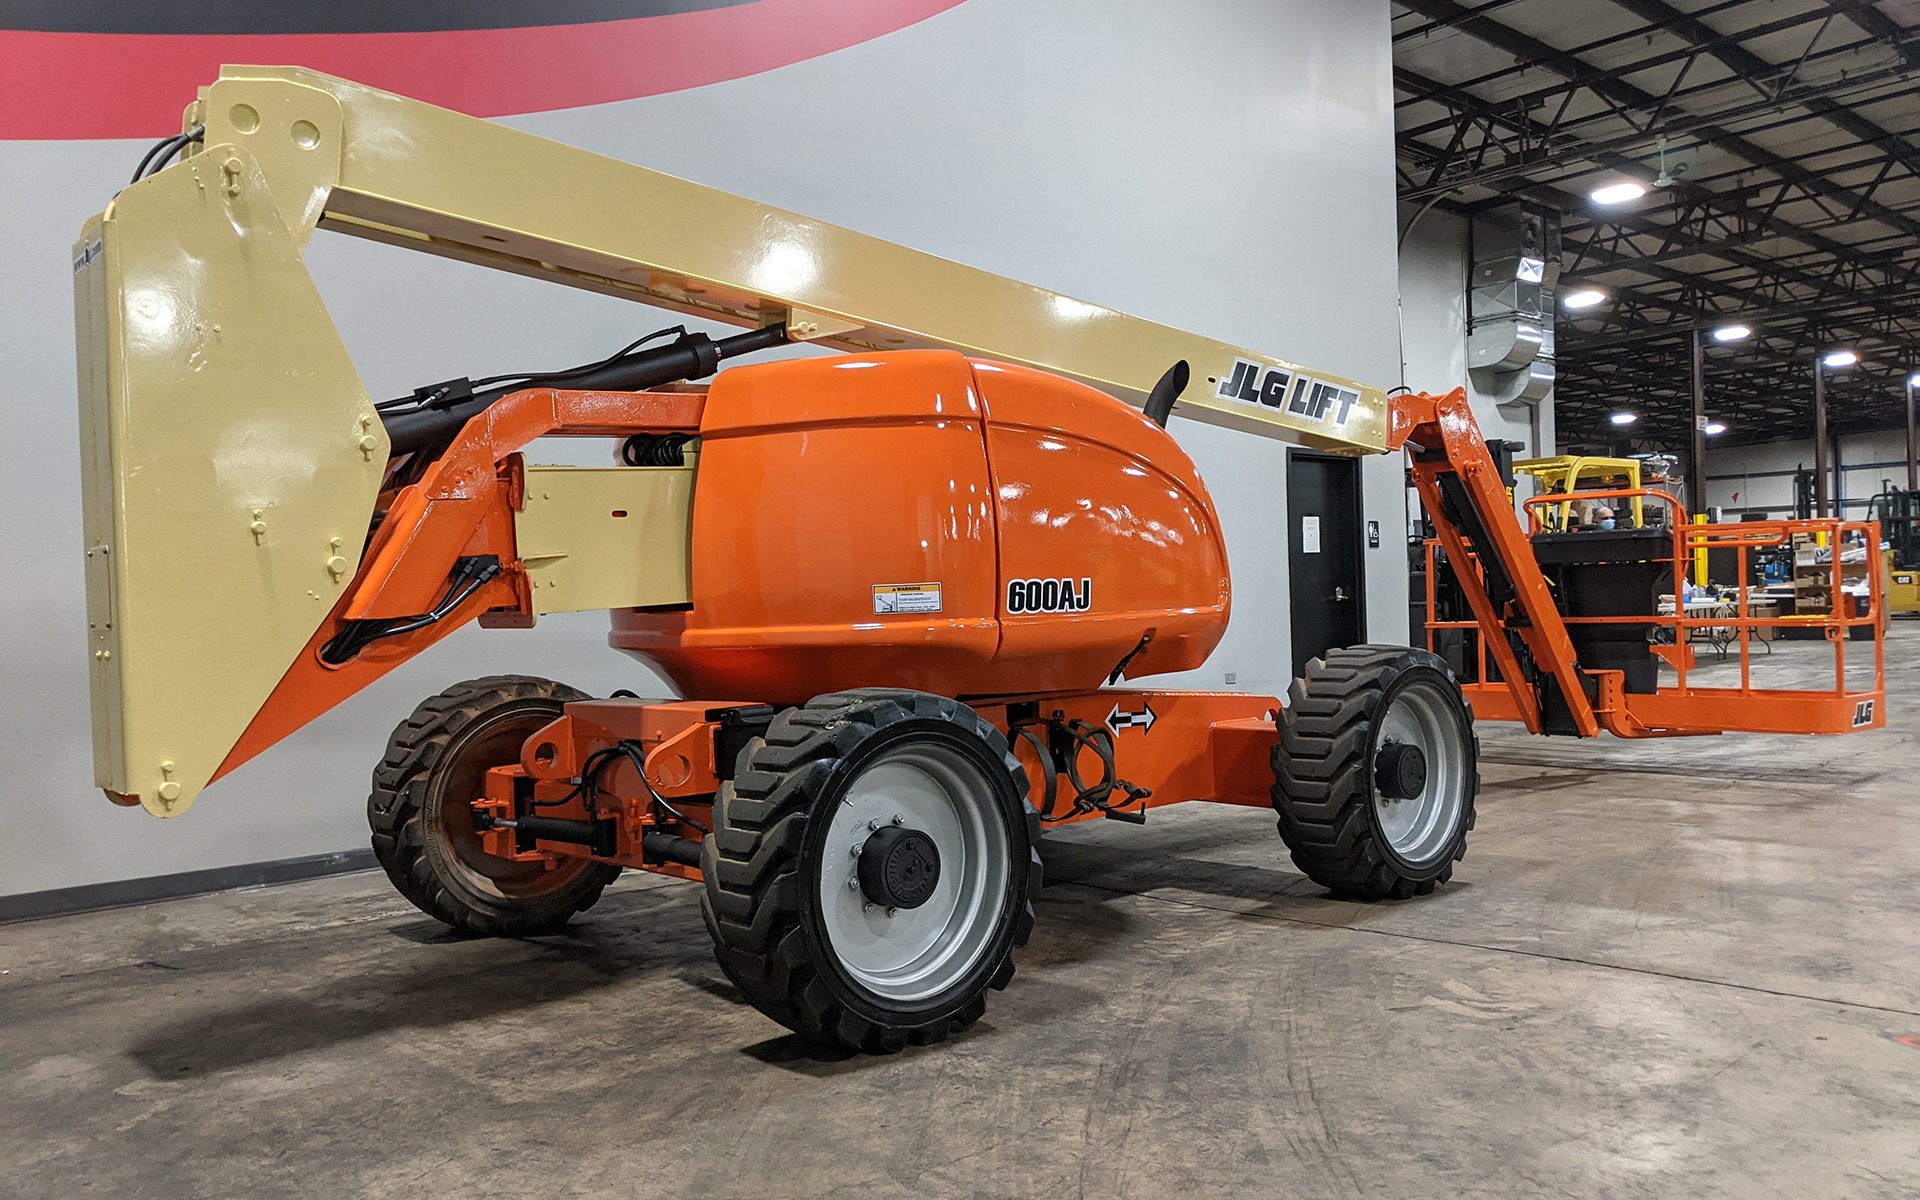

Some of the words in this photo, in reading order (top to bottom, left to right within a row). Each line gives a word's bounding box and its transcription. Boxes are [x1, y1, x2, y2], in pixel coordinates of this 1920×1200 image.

[1218, 361, 1290, 409] JLG
[1288, 378, 1359, 426] LIFT
[1897, 576, 1910, 584] CAT
[1008, 579, 1090, 613] 600AJ
[1853, 702, 1874, 725] JLG
